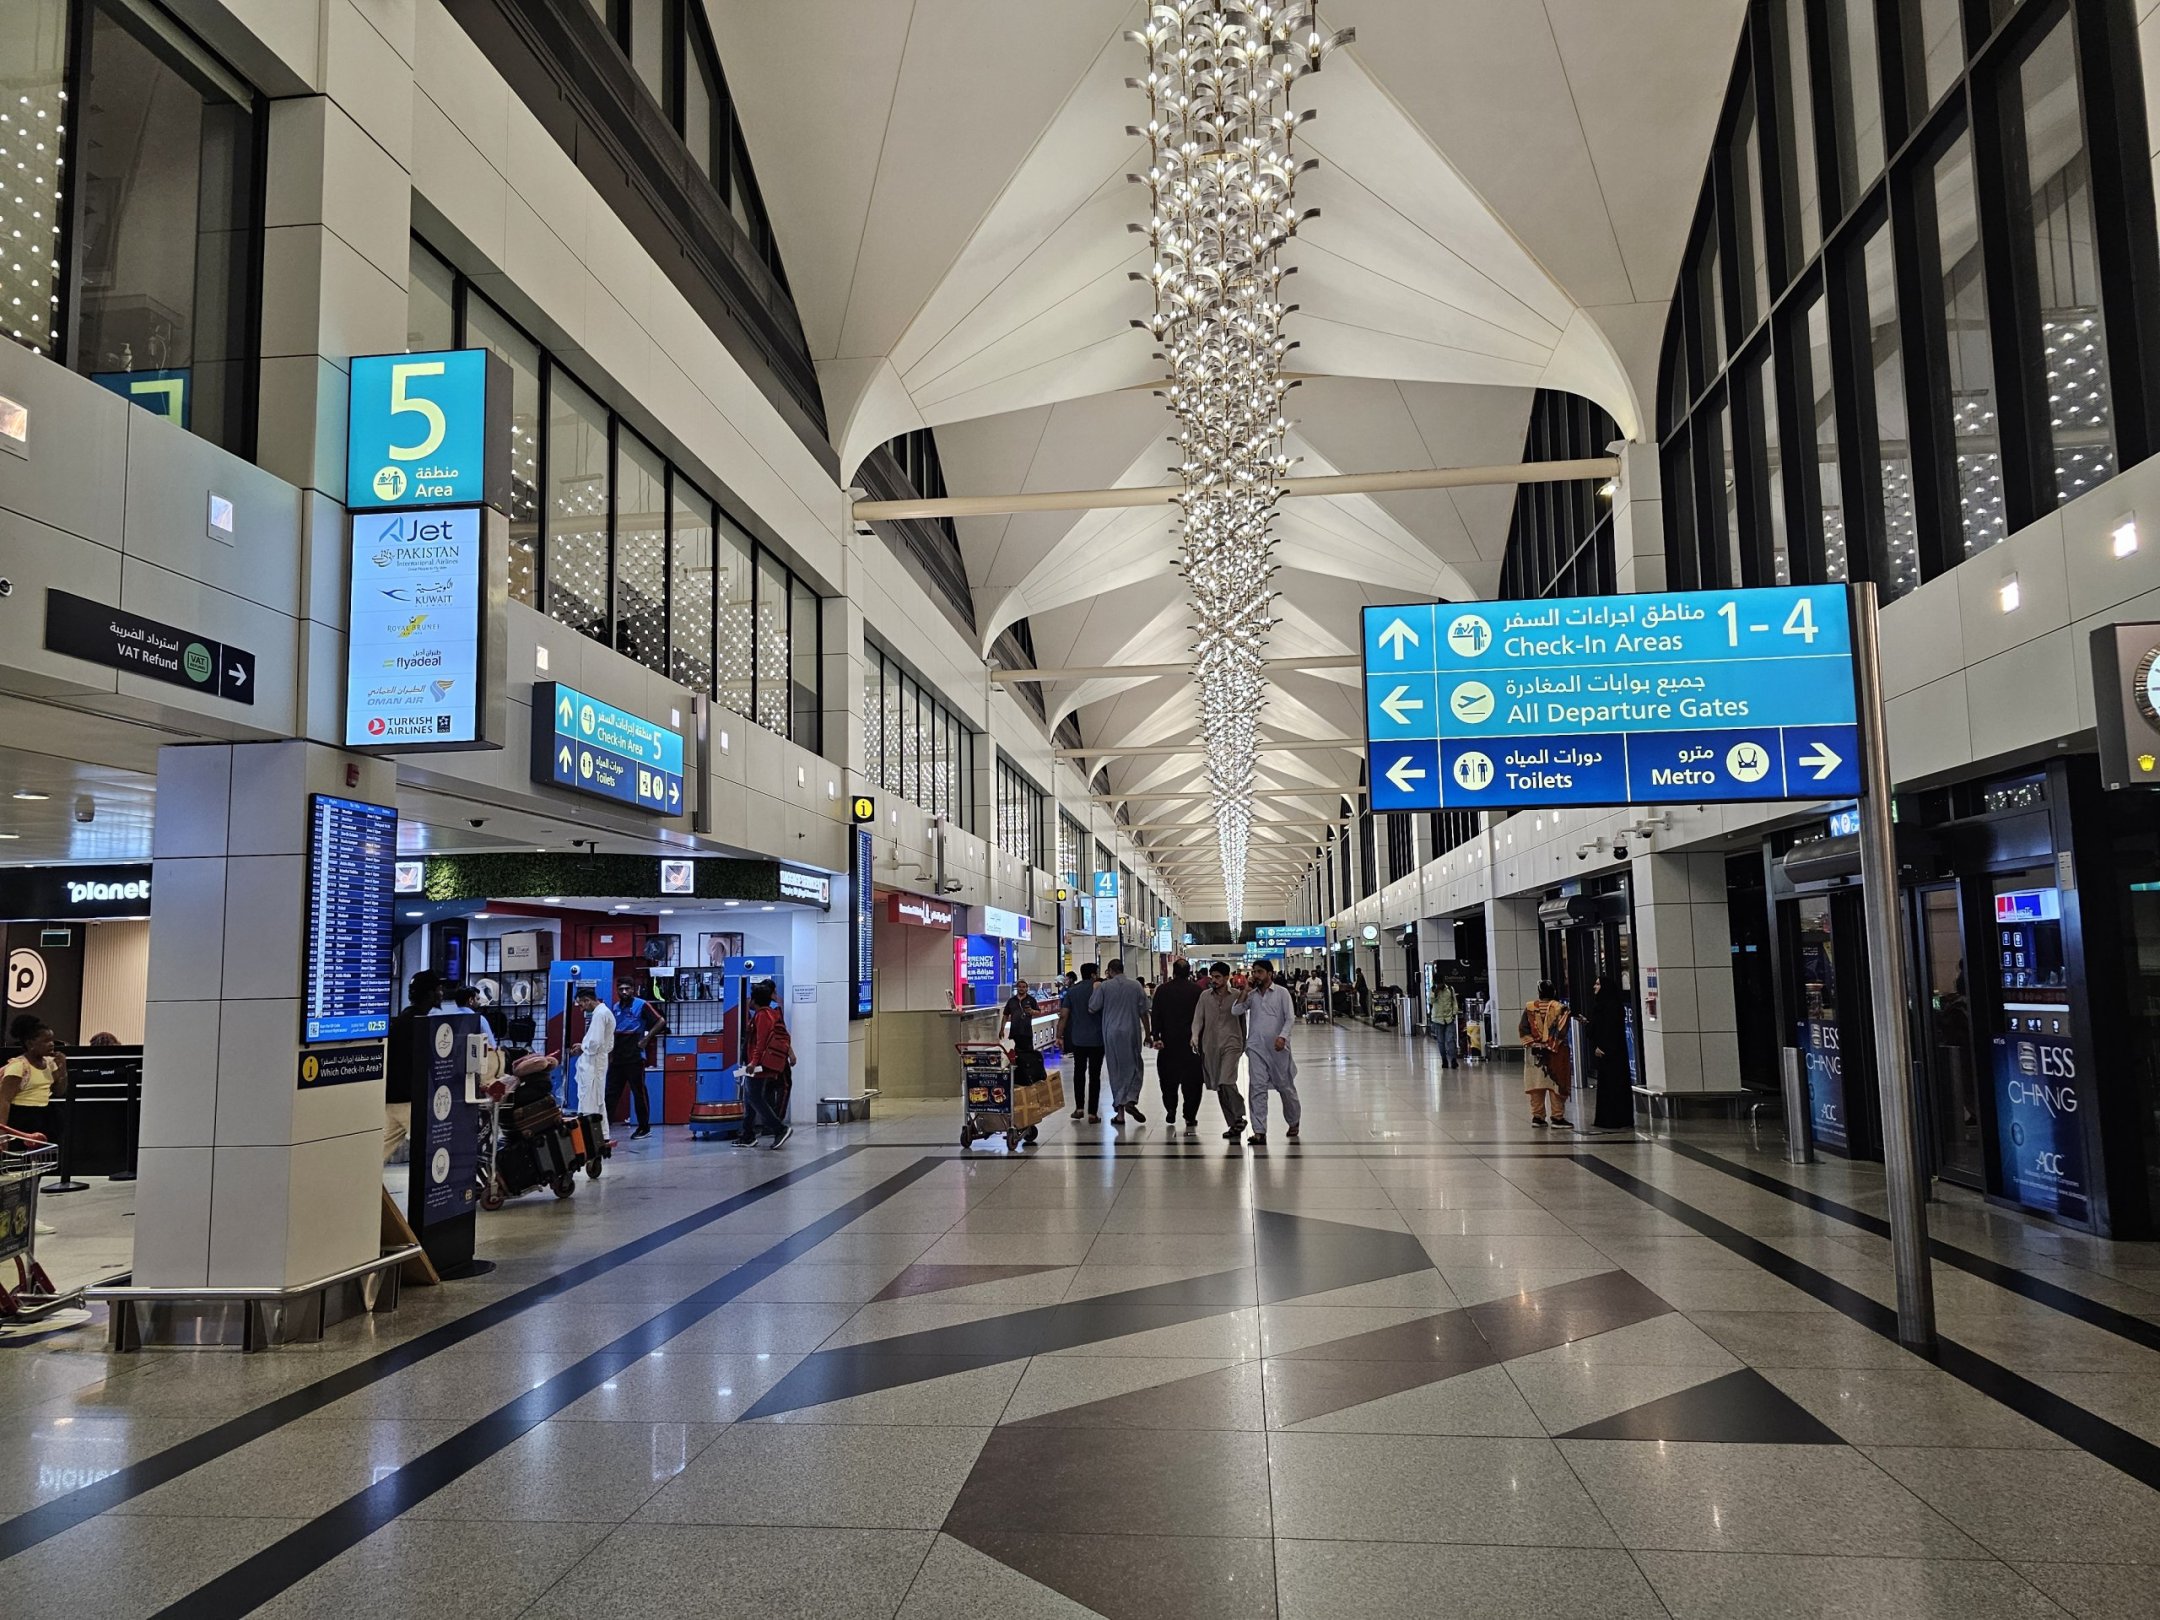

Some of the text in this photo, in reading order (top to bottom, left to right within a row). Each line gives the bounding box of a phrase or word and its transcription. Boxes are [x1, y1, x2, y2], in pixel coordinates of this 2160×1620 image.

[388, 361, 446, 461] 5
[415, 466, 459, 479] منطقة
[415, 484, 453, 498] Area
[396, 546, 460, 560] PAKISTAN
[415, 595, 453, 605] KUWAIT
[1503, 603, 1706, 633] مناطق اجراءات السفر
[110, 621, 179, 652] استرداد الضريبة
[1504, 633, 1683, 657] Check-In Areas
[117, 643, 178, 671] VAT Refund
[190, 653, 205, 666] VAT
[396, 656, 442, 669] flyadeal
[1505, 673, 1706, 699] جميع بوابات المغادرة
[367, 696, 424, 706] OMAN AIR
[388, 716, 433, 726] TURKISH
[1507, 698, 1750, 726] All Departure Gates
[386, 725, 433, 735] AIRLINES
[597, 727, 643, 756] Check-In Area
[653, 731, 662, 760] 5
[1505, 748, 1603, 769] دورات المياه
[1678, 745, 1715, 763] مترو
[596, 771, 616, 787] Toilets
[1506, 771, 1573, 790] Toilets
[1651, 768, 1716, 786] Metro
[1099, 873, 1112, 890] 4
[69, 880, 150, 903] planet
[368, 1021, 386, 1032] 02:53
[321, 1062, 382, 1077] Which Check-In Area?
[2036, 1151, 2064, 1176] ACC
